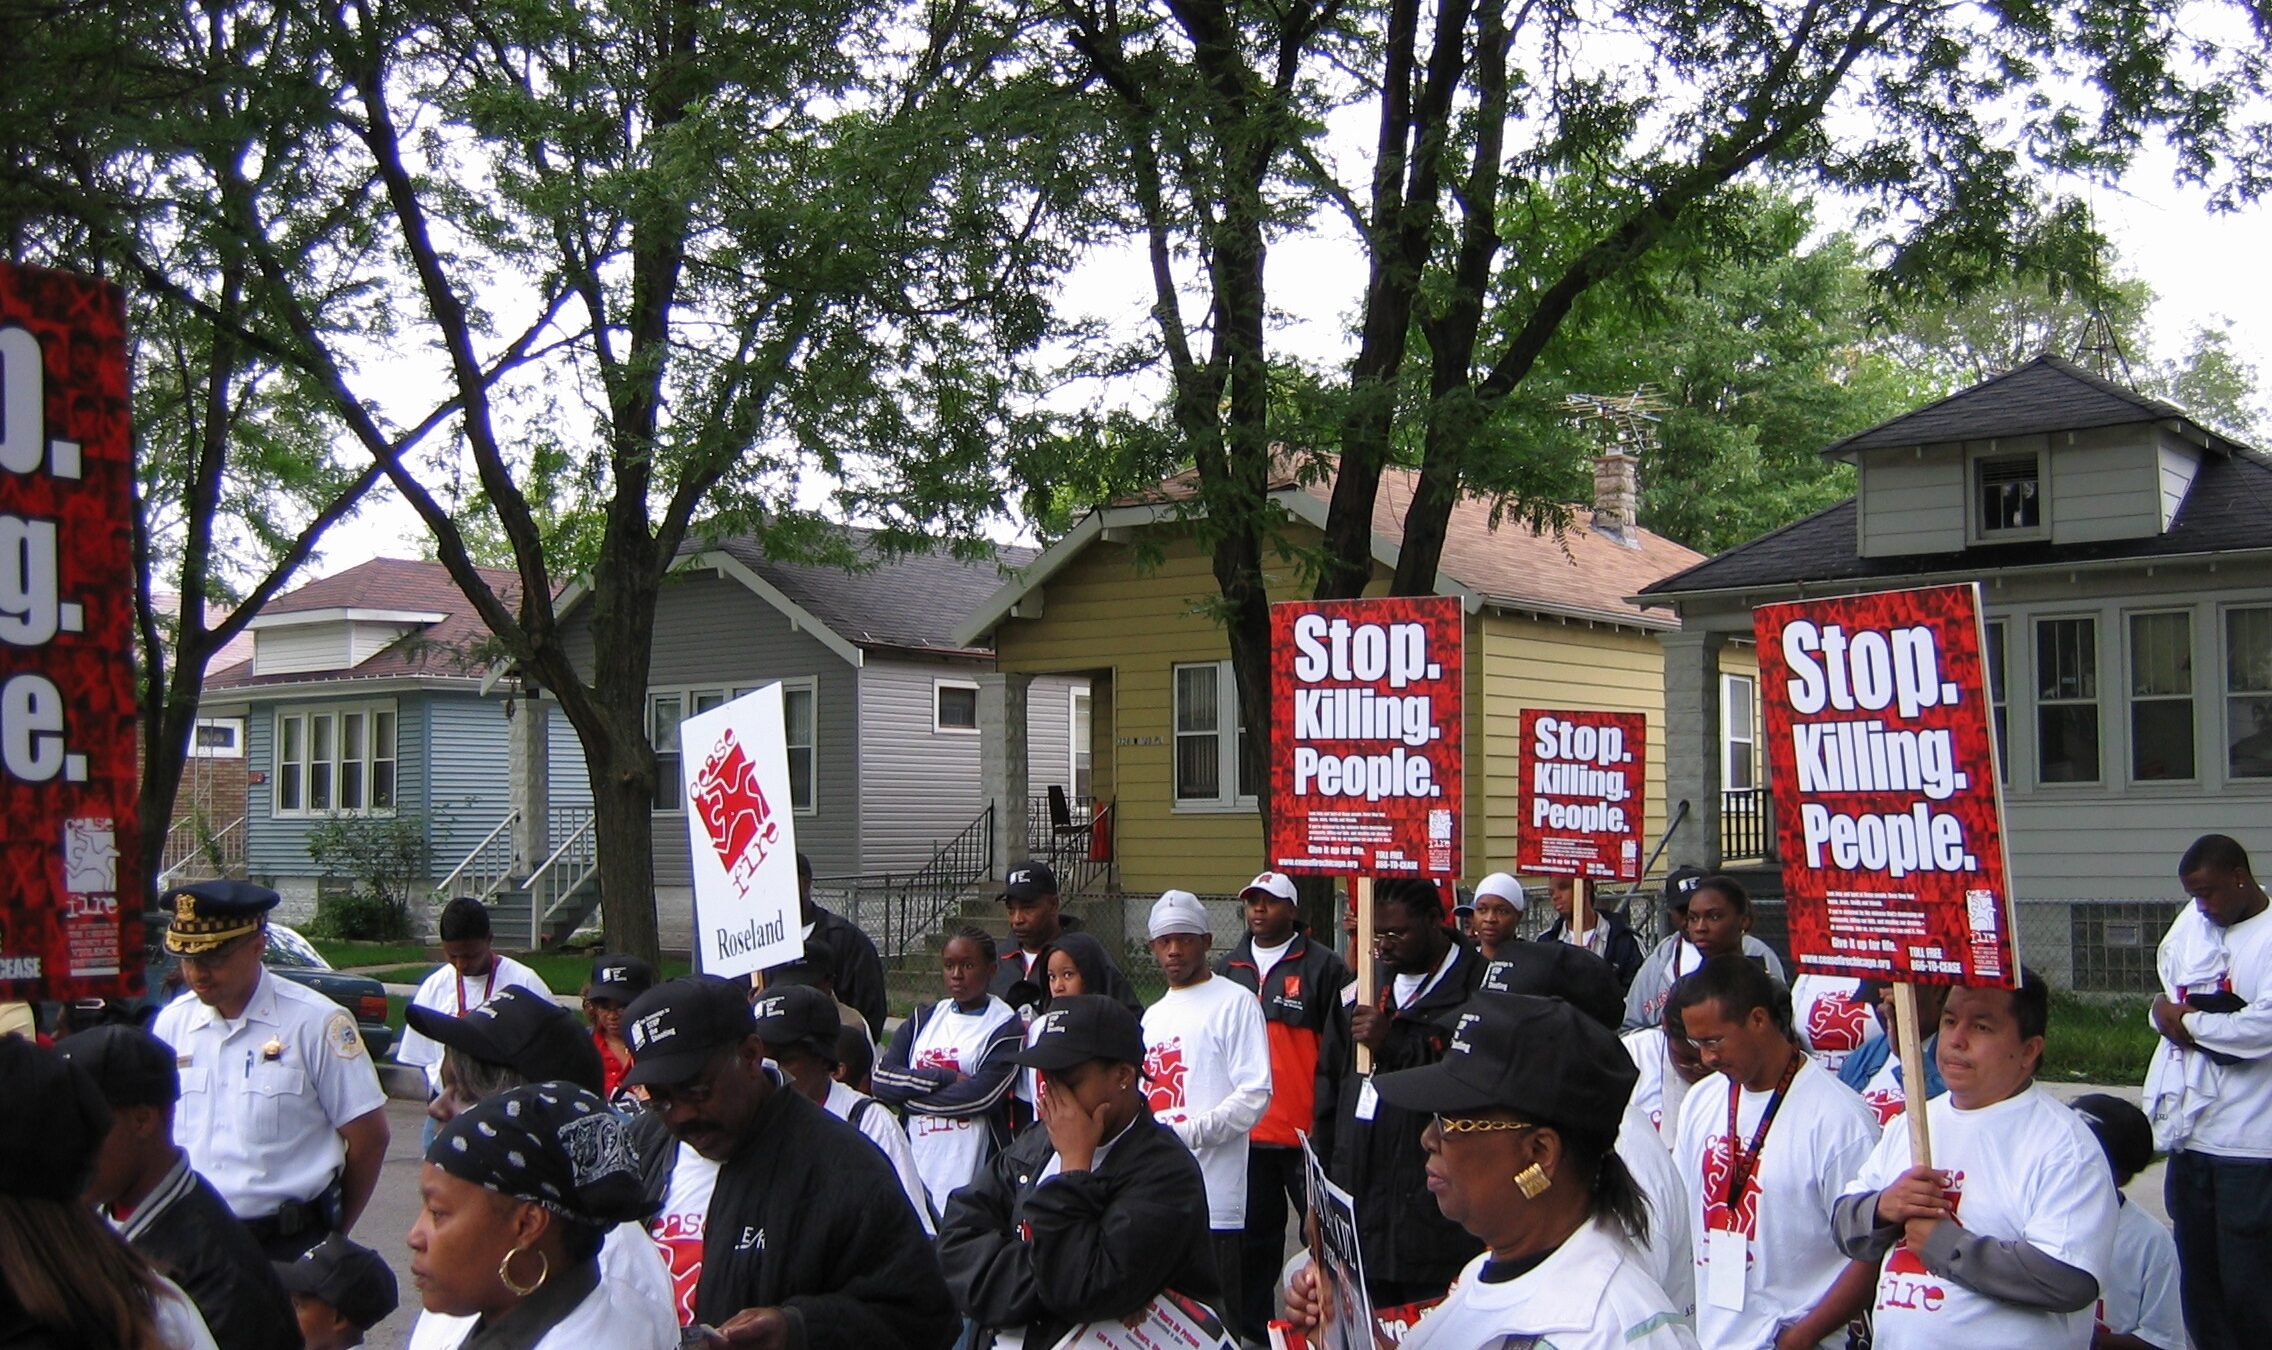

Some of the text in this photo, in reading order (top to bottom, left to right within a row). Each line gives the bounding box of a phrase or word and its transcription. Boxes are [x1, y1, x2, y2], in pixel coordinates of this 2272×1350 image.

[1294, 613, 1442, 688] Stop.
[1782, 619, 1959, 719] Stop.
[1294, 687, 1440, 747] Killing.
[1534, 716, 1632, 766] Stop.
[1294, 747, 1441, 802] People.
[1534, 762, 1631, 802] Killing.
[1791, 719, 1968, 801] Killing.
[65, 817, 115, 831] cease
[1532, 797, 1630, 834] People.
[1800, 801, 1977, 878] People.
[729, 819, 781, 901] fire
[66, 895, 118, 918] fire
[715, 908, 786, 963] Roseland
[915, 1047, 958, 1061] cease
[1877, 1277, 1945, 1311] fire
